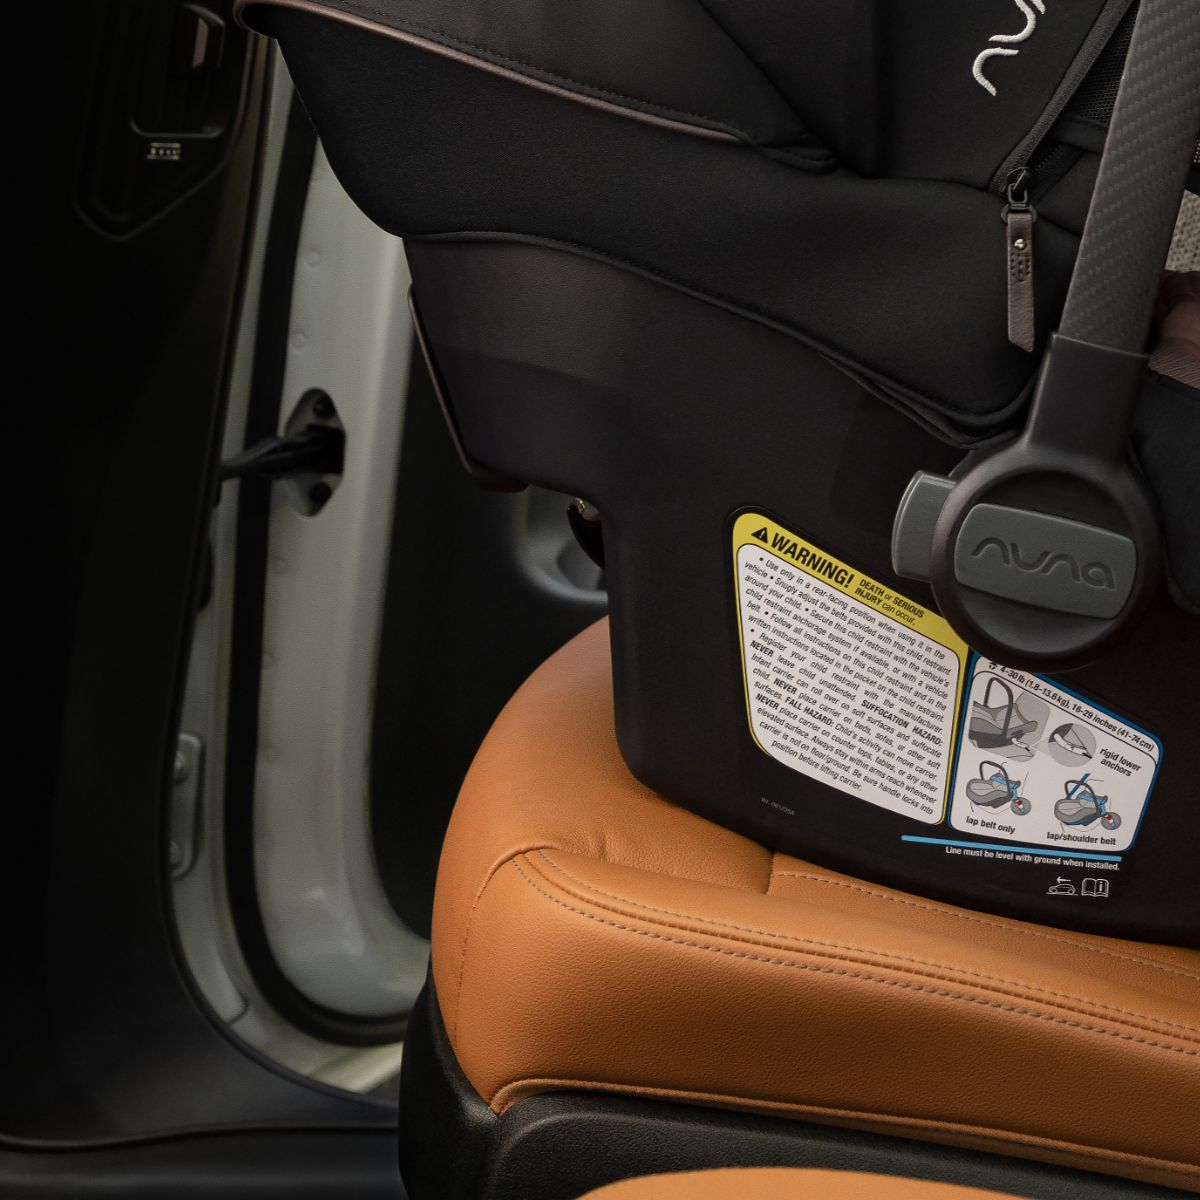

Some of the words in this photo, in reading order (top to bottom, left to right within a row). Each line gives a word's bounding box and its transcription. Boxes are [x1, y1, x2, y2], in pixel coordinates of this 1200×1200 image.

[772, 532, 855, 588] WARNING!
[855, 587, 882, 606] INJURY
[882, 602, 896, 613] can
[896, 610, 916, 625] occur.
[860, 579, 885, 597] DEATH
[892, 597, 925, 618] SERIOUS
[970, 537, 1117, 590] nuna
[744, 561, 768, 578] vehicle
[774, 577, 798, 595] Snugly
[797, 591, 819, 606] adjust
[818, 601, 830, 612] the
[830, 607, 848, 621] belts
[846, 618, 877, 636] provided
[877, 633, 892, 644] with
[892, 640, 906, 652] this
[905, 648, 924, 660] child
[922, 657, 951, 675] restraint
[744, 574, 769, 591] around
[767, 588, 784, 599] your
[784, 596, 802, 611] child.
[809, 608, 833, 626] Secure
[833, 622, 847, 633] this
[847, 630, 865, 642] child
[864, 639, 893, 658] restraint
[893, 654, 908, 666] with
[908, 661, 920, 672] the
[920, 668, 950, 687] vehicle's
[745, 588, 764, 600] child
[763, 597, 792, 616] restraint
[792, 613, 827, 635] anchorage
[827, 632, 852, 649] system
[852, 644, 860, 652] if
[859, 649, 890, 671] available,
[901, 671, 916, 683] with
[924, 683, 948, 699] vehicle
[746, 600, 761, 614] belt.
[769, 612, 792, 629] Follow
[792, 626, 803, 635] all
[802, 630, 841, 656] instructions
[842, 653, 852, 661] on
[852, 657, 866, 669] this
[866, 666, 884, 678] child
[884, 675, 913, 693] restraint
[913, 690, 928, 700] and
[926, 696, 934, 705] in
[934, 700, 947, 711] the
[765, 559, 779, 571] Use
[779, 568, 795, 580] only
[796, 576, 804, 585] in
[811, 586, 848, 610] rear-facing
[848, 606, 876, 623] position
[877, 621, 896, 634] when
[897, 631, 916, 646] using
[917, 640, 924, 648] it
[933, 649, 945, 659] the
[748, 614, 771, 631] written
[770, 626, 809, 651] instructions
[809, 646, 835, 664] located
[833, 660, 842, 668] in
[842, 664, 854, 674] the
[853, 671, 877, 687] pocket
[876, 683, 886, 692] on
[886, 687, 898, 698] the
[898, 695, 916, 707] child
[915, 704, 944, 723] restraint.
[749, 640, 774, 657] NEVER
[776, 654, 795, 668] leave
[798, 667, 816, 680] child
[818, 678, 857, 703] unattended.
[860, 699, 909, 728] SUFFOCATION
[911, 725, 943, 746] HAZARD:
[751, 653, 771, 668] Infant
[772, 665, 795, 680] carrier
[796, 678, 809, 688] can
[810, 686, 823, 695] roll
[823, 693, 840, 704] over
[840, 702, 850, 710] on
[851, 708, 866, 718] soft
[866, 716, 895, 734] surfaces
[895, 731, 910, 741] and
[910, 738, 942, 758] suffocate
[1000, 666, 1018, 680] 4-30
[1072, 704, 1093, 719] 16-29
[1092, 714, 1117, 732] inches
[752, 667, 771, 682] child.
[772, 677, 797, 694] NEVER
[797, 692, 817, 705] place
[818, 703, 841, 718] carrier
[842, 716, 852, 724] on
[854, 720, 872, 736] beds,
[874, 732, 894, 748] sofas,
[906, 749, 925, 761] other
[926, 759, 941, 770] soft
[753, 680, 783, 701] surfaces.
[784, 696, 802, 710] FALL
[802, 706, 834, 727] HAZARD:
[834, 723, 858, 739] Child's
[857, 736, 882, 752] activity
[882, 748, 895, 759] can
[895, 755, 914, 768] move
[914, 765, 938, 782] carrier.
[755, 693, 780, 710] NEVER
[778, 707, 798, 720] place
[798, 717, 820, 732] carrier
[820, 729, 830, 737] on
[830, 734, 857, 750] counter
[856, 746, 873, 761] tops,
[874, 756, 896, 773] tables,
[906, 773, 920, 783] any
[919, 780, 938, 792] other
[1100, 748, 1119, 761] rigid
[1119, 756, 1142, 771] lower
[759, 721, 781, 735] carrier
[789, 737, 802, 747] not
[800, 743, 810, 751] on
[810, 747, 851, 774] floor/ground.
[852, 768, 862, 778] Be
[862, 775, 878, 786] sure
[878, 782, 901, 798] handle
[901, 794, 919, 807] locks
[919, 803, 933, 814] into
[1100, 759, 1132, 776] anchors
[946, 846, 962, 855] Line
[963, 848, 983, 857] must
[996, 851, 1014, 860] level
[1015, 853, 1032, 862] with
[1034, 856, 1060, 866] ground
[1063, 858, 1084, 867] when
[1085, 860, 1120, 870] installed.
[966, 816, 978, 826] lap
[980, 818, 996, 829] belt
[998, 824, 1016, 834] only
[1047, 832, 1098, 844] lap/shoulder
[1100, 836, 1116, 845] belt
